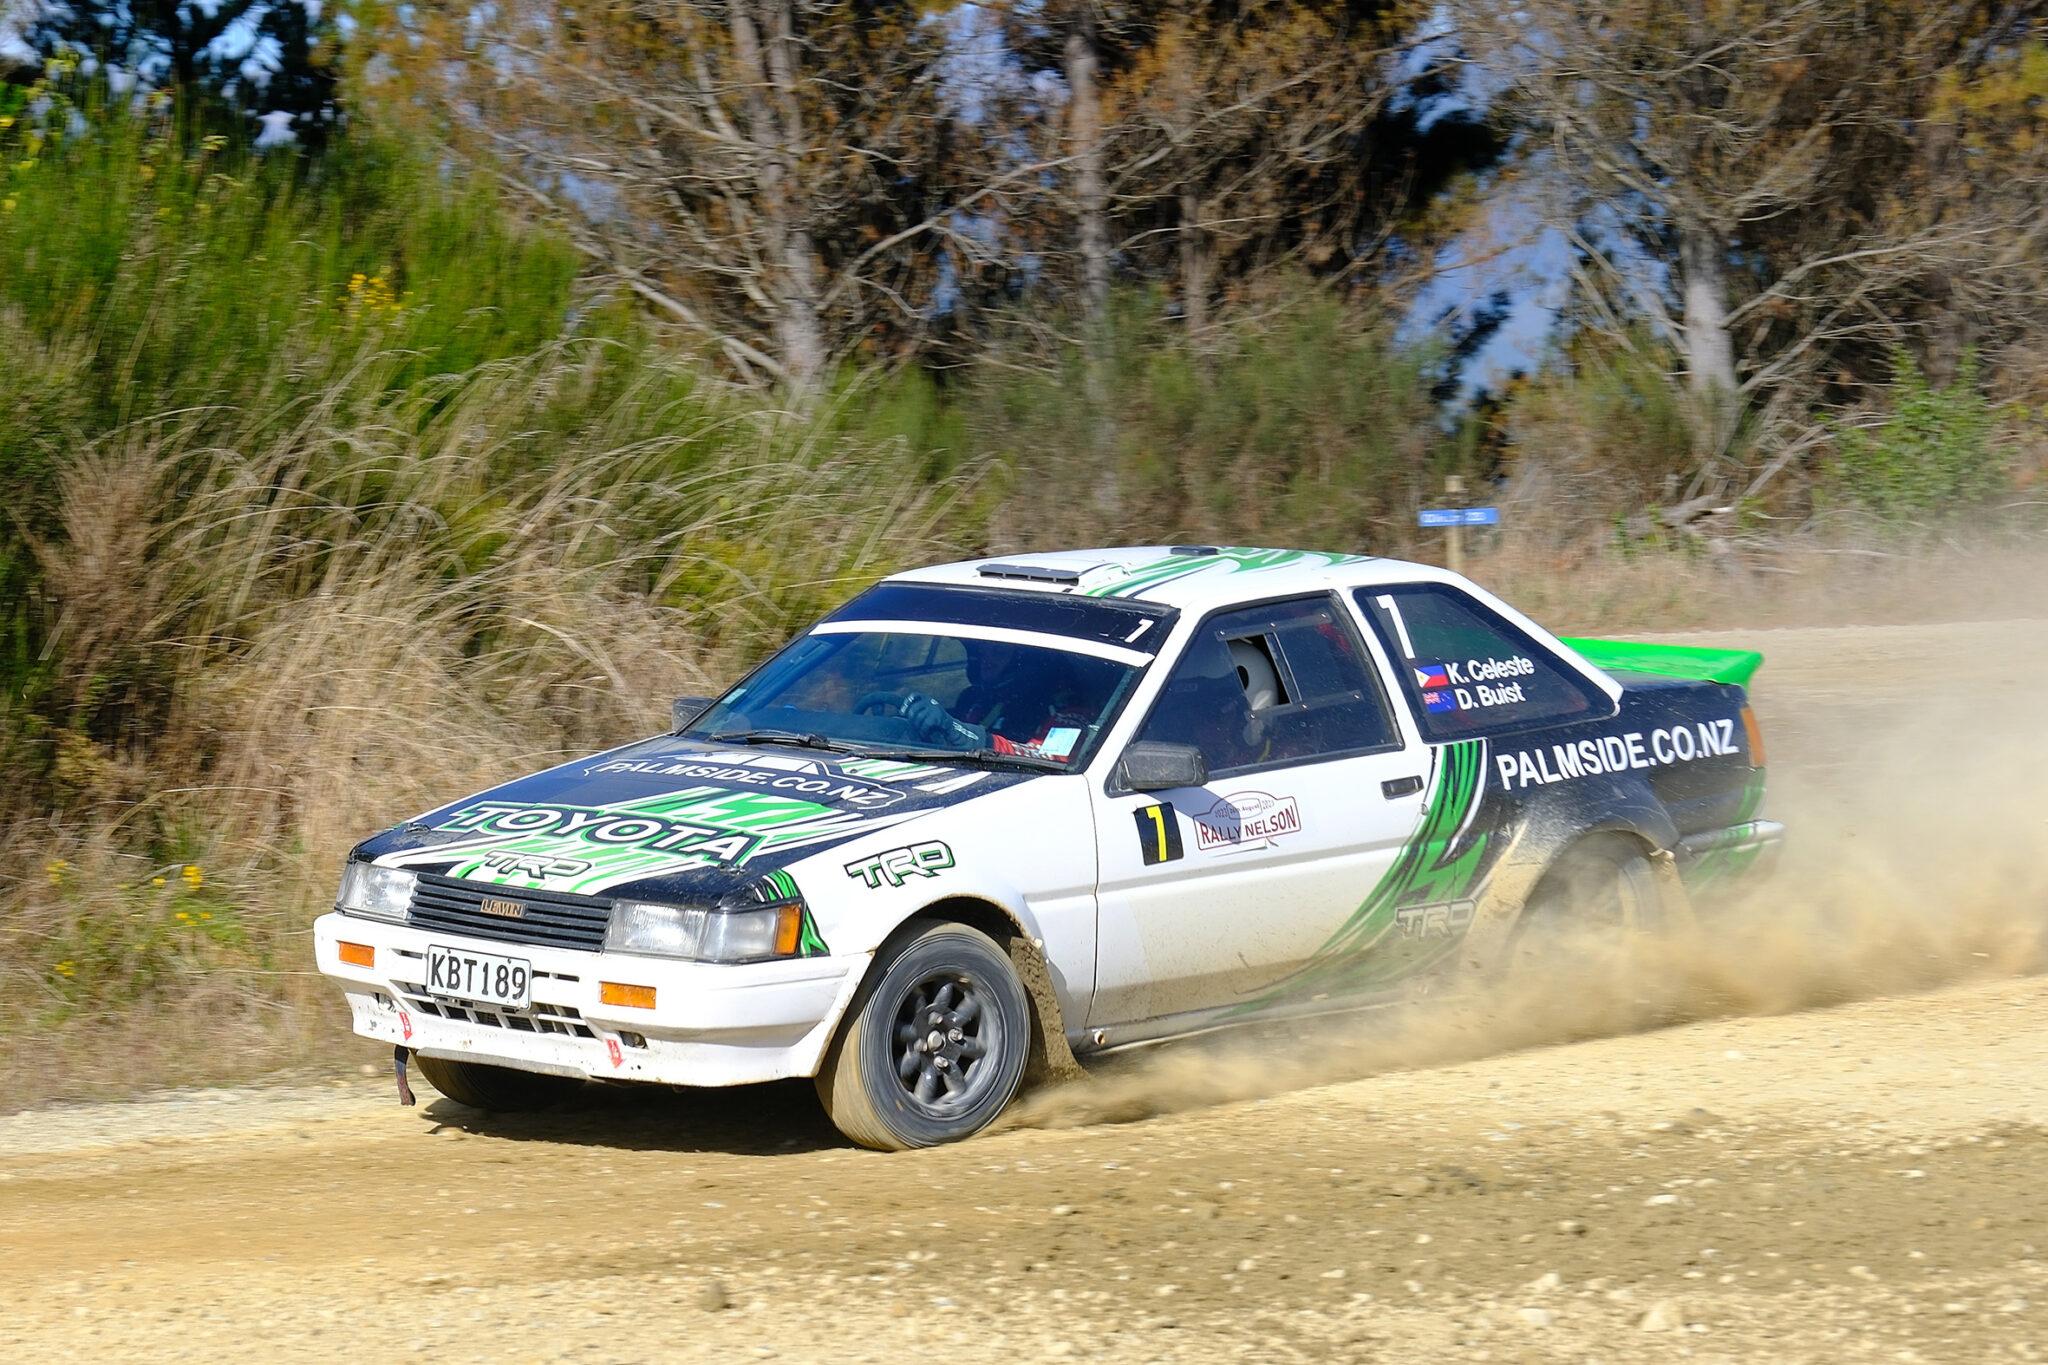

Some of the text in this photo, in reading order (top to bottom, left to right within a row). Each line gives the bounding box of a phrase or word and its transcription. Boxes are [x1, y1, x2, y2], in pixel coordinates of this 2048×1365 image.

[1124, 618, 1155, 643] 1
[1376, 594, 1416, 660] 1
[1445, 655, 1535, 685] K. Celeste
[1455, 682, 1526, 710] D. Buist
[1496, 718, 1740, 791] PALMSIDE.CO.NZ
[600, 759, 891, 807] PALMSIDE.CO.NZ
[453, 804, 758, 864] TOYOTA
[1146, 805, 1167, 861] 1
[1200, 804, 1297, 845] RALLY NELSON
[485, 850, 592, 879] TRD
[843, 840, 955, 888] TRD
[481, 900, 523, 917] LEVIN
[1395, 898, 1477, 939] TRD
[430, 953, 526, 1000] KBT189
